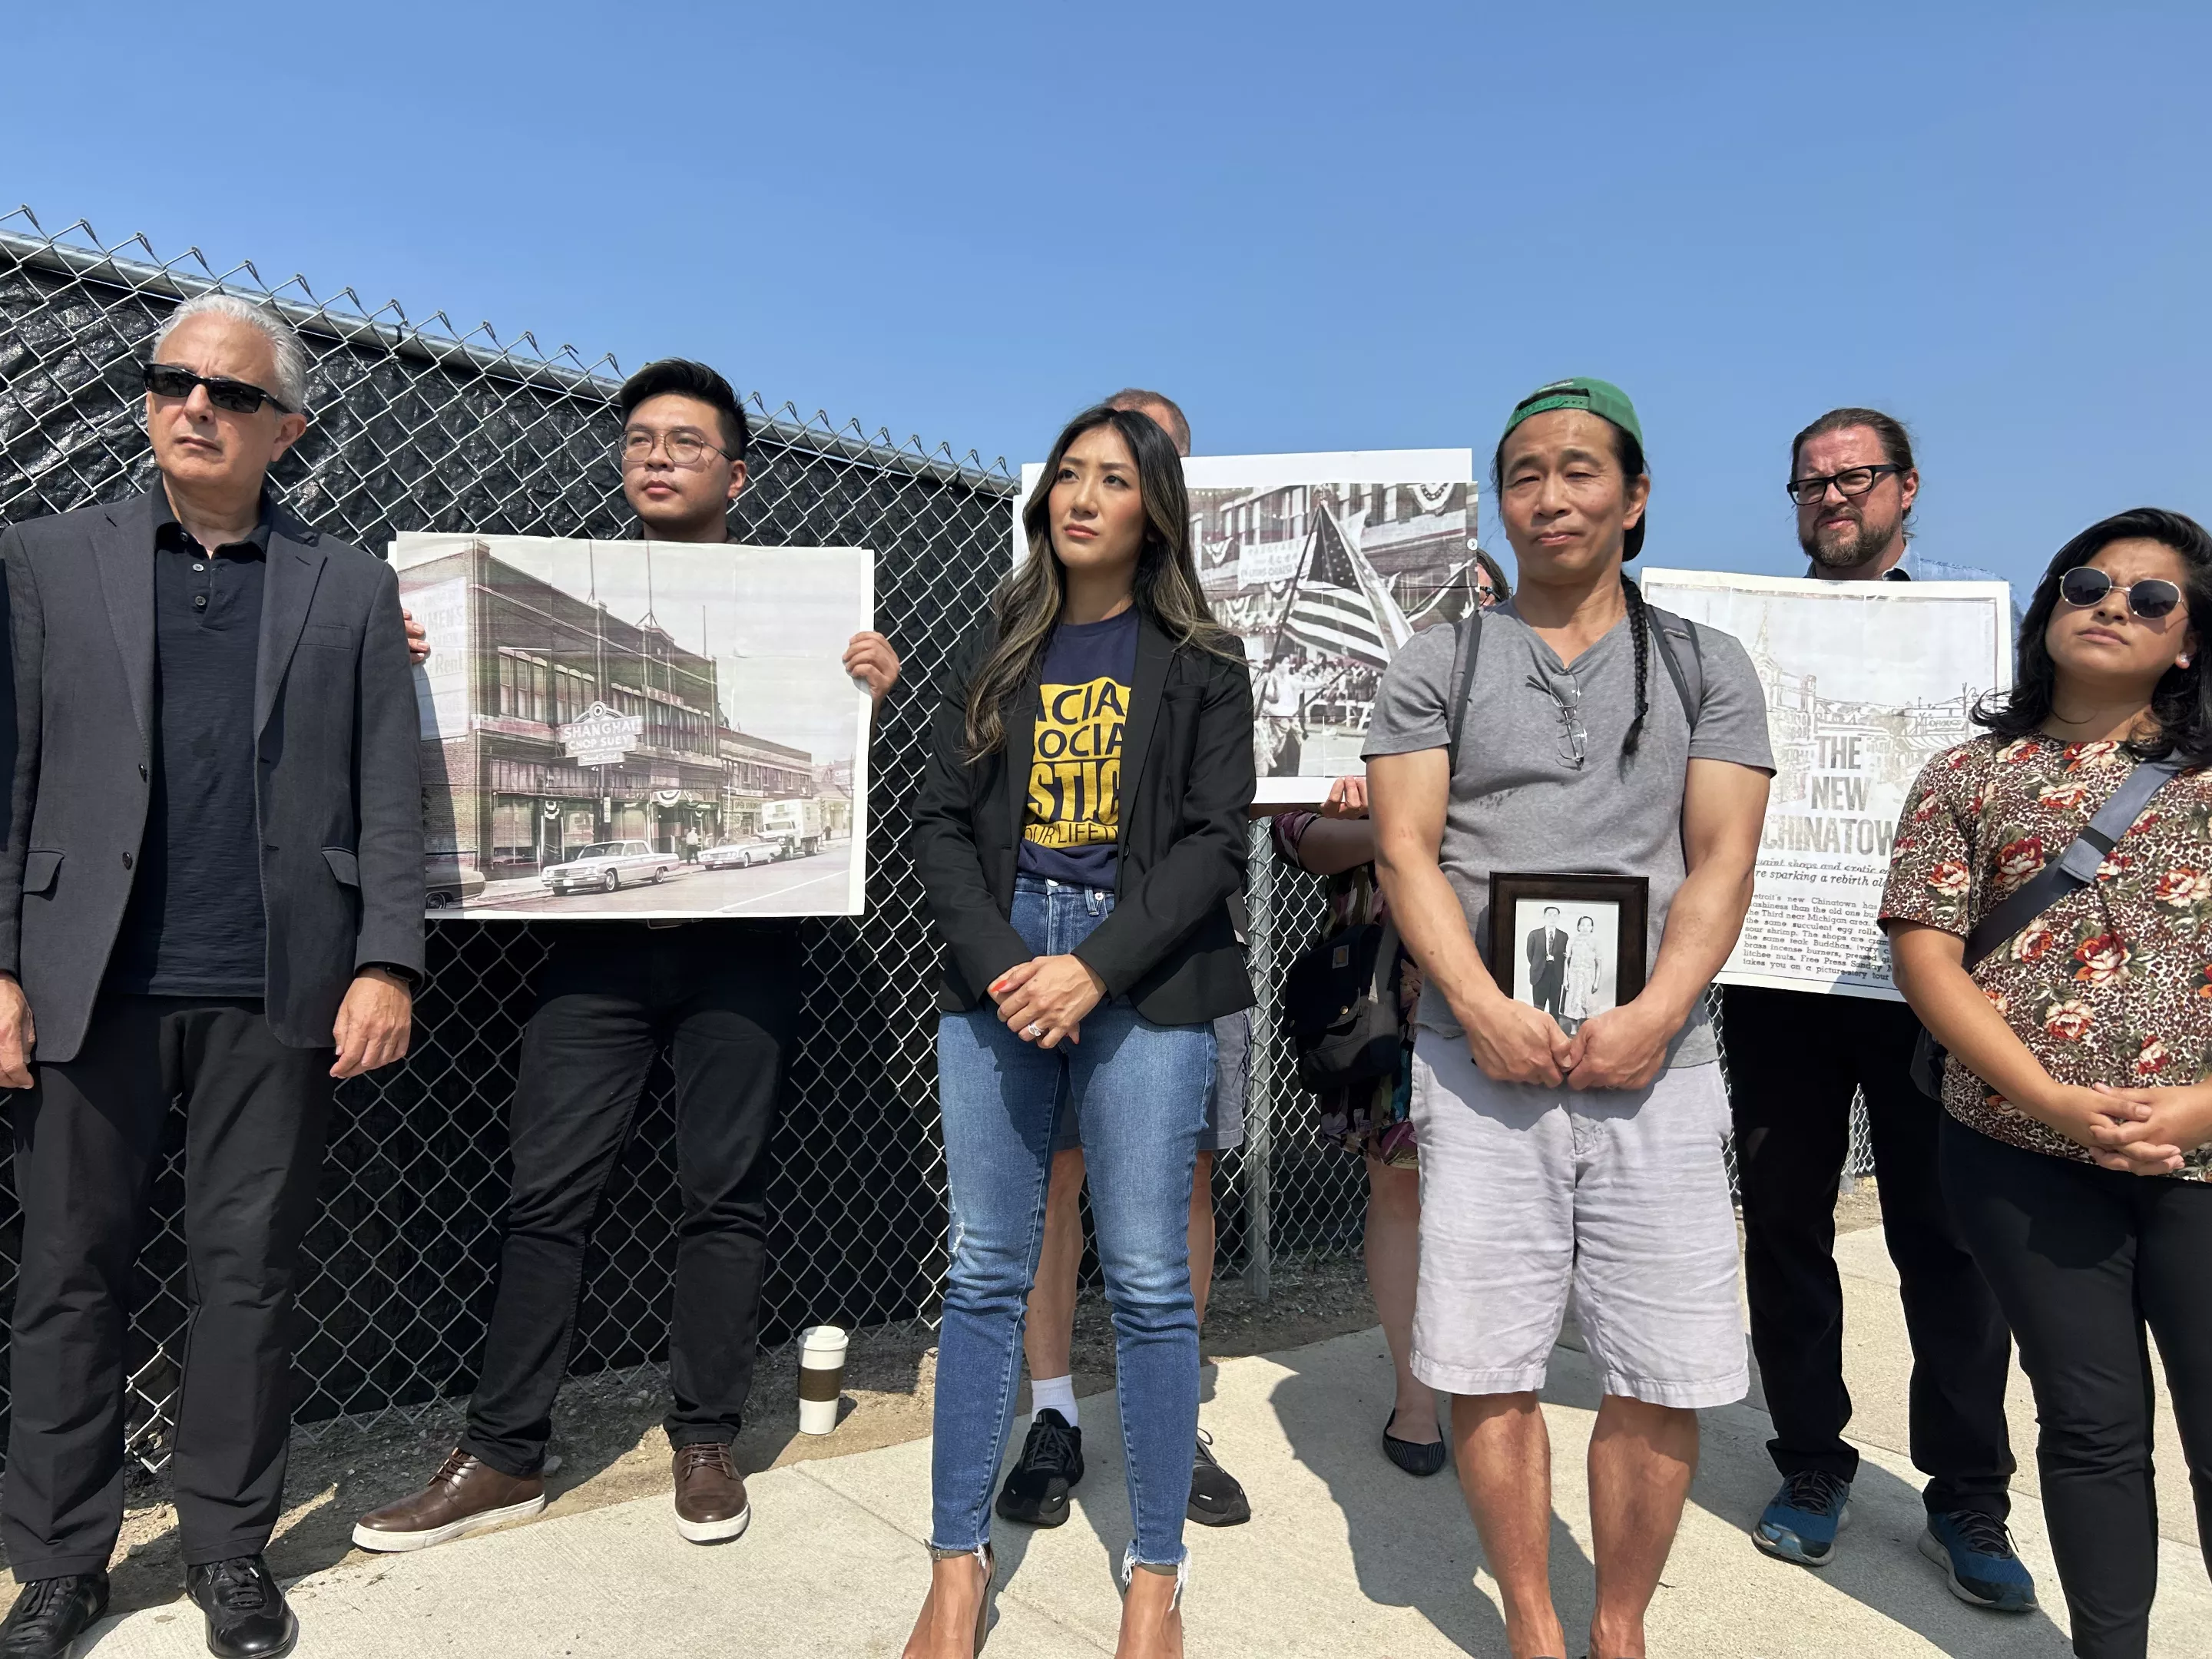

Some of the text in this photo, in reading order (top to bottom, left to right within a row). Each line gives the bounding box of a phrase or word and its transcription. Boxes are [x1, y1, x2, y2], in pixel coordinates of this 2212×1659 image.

[564, 719, 637, 739] SHANGHAI
[569, 735, 629, 751] CHOP SUEY
[1815, 736, 1862, 770] THE
[1811, 776, 1871, 812] NEW
[1788, 859, 1817, 870] shops
[1820, 862, 1842, 871] and
[1770, 870, 1817, 883] sparking
[1830, 875, 1869, 886] rebirth
[1791, 904, 1810, 912] than
[1811, 897, 1856, 908] Chinatown
[1762, 909, 1783, 919] Third
[1807, 913, 1846, 925] Michigan
[1767, 927, 1798, 938] shrimp.
[1823, 933, 1846, 942] shops
[1793, 922, 1832, 931] succulent
[1744, 940, 1767, 949] brass
[1770, 944, 1803, 953] incense
[1806, 947, 1841, 958] burners,
[1845, 952, 1877, 962] pressed
[1743, 949, 1771, 959] litchee
[1800, 955, 1820, 963] Free
[1824, 957, 1846, 966] Press
[1850, 960, 1883, 972] Sunday
[1743, 958, 1766, 966] takes
[1770, 962, 1786, 970] you
[1816, 966, 1868, 980] picture-story
[1872, 972, 1890, 981] tour
